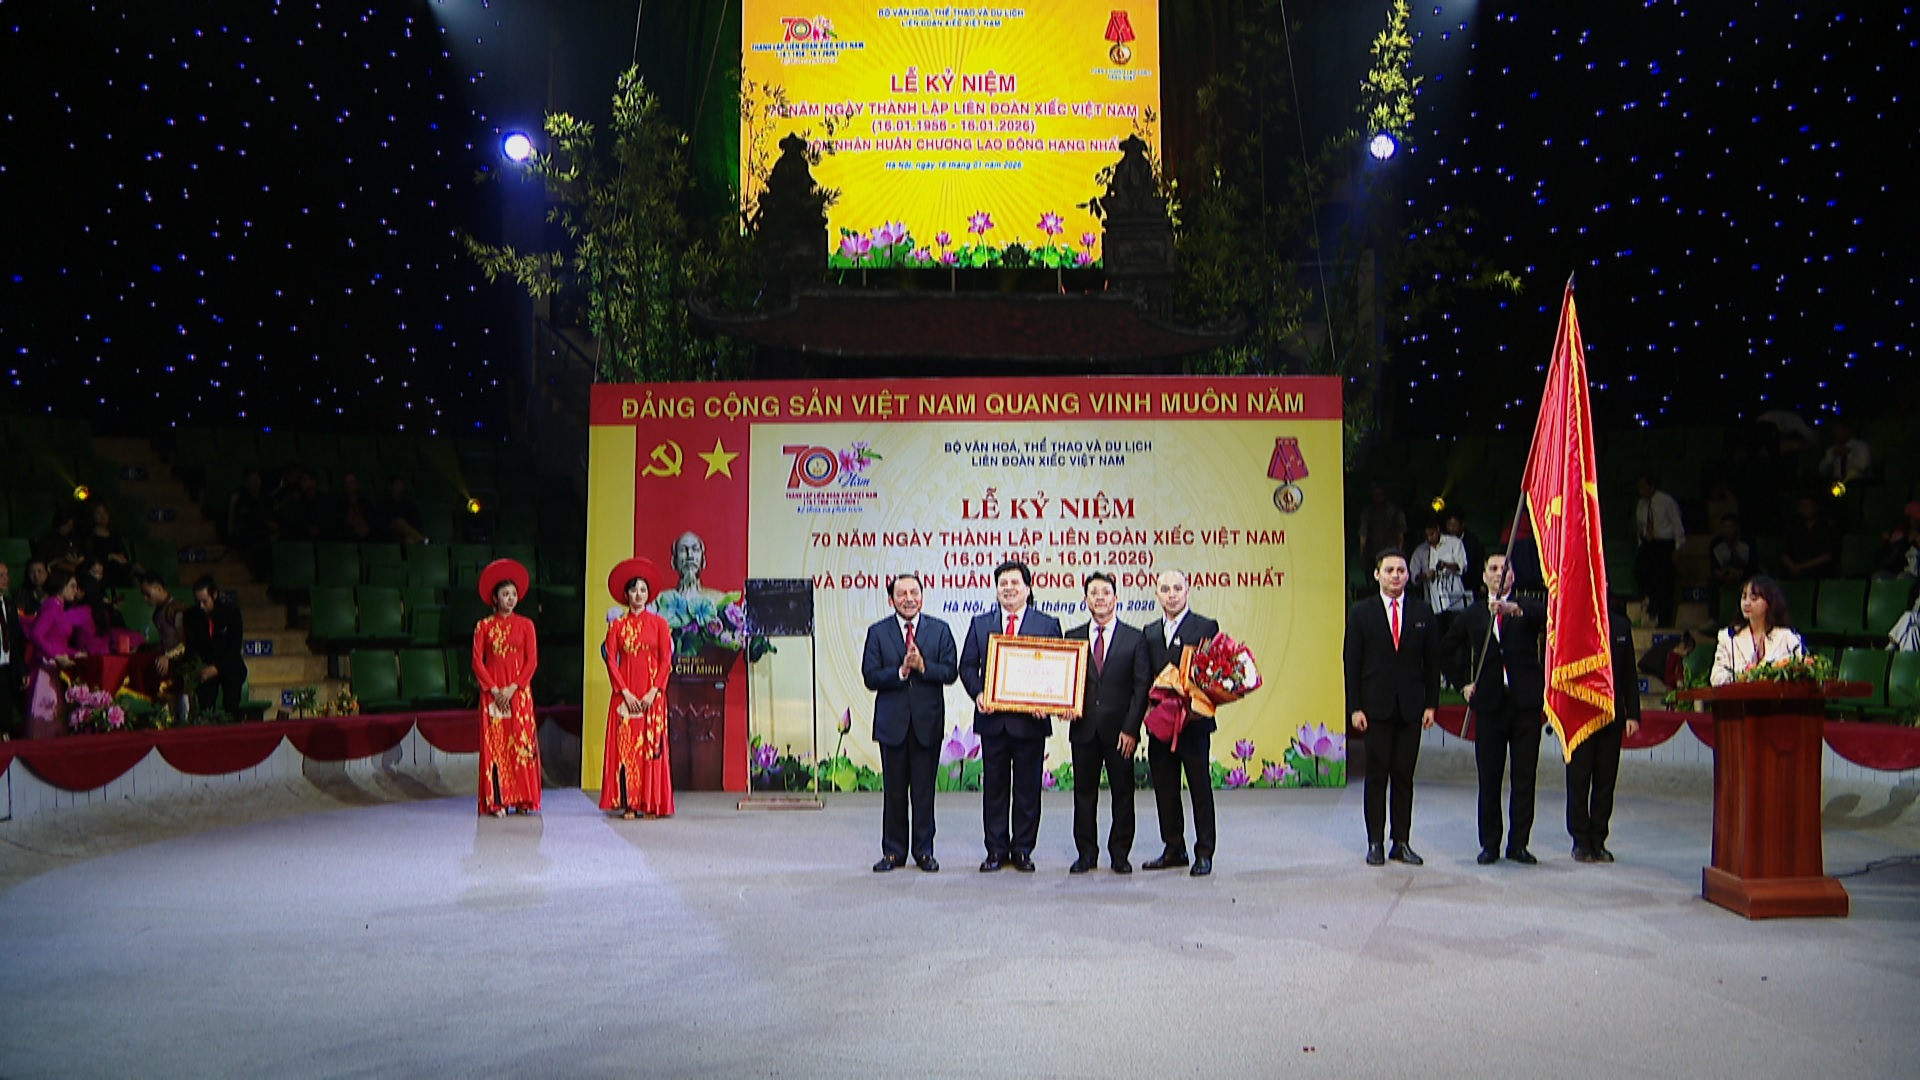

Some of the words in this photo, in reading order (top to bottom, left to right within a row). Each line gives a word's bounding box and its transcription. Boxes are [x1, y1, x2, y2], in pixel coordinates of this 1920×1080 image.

[954, 8, 975, 16] THAO
[991, 8, 1002, 16] DU
[782, 17, 812, 41] 70
[892, 66, 917, 92] LỄ
[926, 68, 954, 92] KỶ
[963, 70, 1015, 96] NIỆM
[789, 101, 819, 116] NĂM
[825, 100, 863, 115] NGÀY
[869, 101, 917, 115] THÀNH
[922, 101, 948, 117] LẬP
[954, 100, 985, 115] LIÊN
[990, 101, 1030, 115] ĐOÀN
[1035, 99, 1066, 115] XIẾC
[1072, 100, 1103, 119] VIỆT
[1107, 103, 1138, 116] NAM
[872, 119, 947, 134] (16.01.1956
[961, 119, 1035, 134] 16.01.2026)
[835, 136, 871, 152] NHẬN
[876, 136, 911, 150] HUÂN
[916, 137, 972, 151] CHƯƠNG
[977, 139, 1002, 151] LAO
[1007, 137, 1044, 152] ĐỘNG
[1050, 139, 1085, 153] HẠNG
[1090, 136, 1119, 151] NHẤ
[916, 162, 935, 171] ngày
[949, 161, 971, 171] tháng
[985, 161, 1001, 169] năm
[1004, 161, 1022, 169] 2026
[622, 390, 695, 419] ĐẢNG
[704, 391, 780, 422] CỘNG
[789, 386, 842, 416] SẢN
[852, 388, 909, 420] VIỆT
[919, 393, 976, 415] NAM
[985, 392, 1080, 416] QUANG
[1089, 392, 1151, 414] VINH
[1161, 386, 1238, 414] MUÔN
[1248, 386, 1304, 413] NĂM
[945, 440, 961, 454] BỘ
[965, 439, 988, 453] VĂN
[1024, 437, 1047, 453] THỂ
[1051, 441, 1083, 453] THAO
[1086, 438, 1100, 452] VÀ
[1105, 441, 1121, 452] DU
[1126, 440, 1151, 454] LỊCH
[783, 444, 838, 489] 70
[972, 455, 998, 467] LIÊN
[1002, 455, 1035, 466] ĐOÀN
[1039, 453, 1065, 466] XIẾC
[1070, 454, 1095, 468] VIỆT
[1100, 455, 1125, 466] NAM
[962, 487, 1000, 519] LỄ
[1011, 490, 1049, 519] KỶ
[1060, 490, 1135, 525] NIỆM
[812, 532, 830, 547] 70
[837, 529, 876, 547] NĂM
[883, 528, 933, 547] NGÀY
[939, 528, 1001, 547] THÀNH
[1008, 528, 1042, 550] LẬP
[1050, 527, 1089, 546] LIÊN
[1096, 526, 1147, 545] ĐOÀN
[1154, 524, 1194, 545] XIẾC
[1201, 526, 1240, 548] VIỆT
[1247, 530, 1285, 545] NAM
[944, 551, 1040, 570] (16.01.1956
[1058, 551, 1154, 569] 16.01.2026)
[812, 570, 835, 589] VÀ
[841, 570, 878, 589] ĐÓN
[941, 570, 991, 589] HUÂN
[1123, 568, 1160, 591] ĐỘN
[1238, 566, 1284, 587] NHẤT
[943, 600, 958, 613] Hà
[963, 600, 985, 614] Nội,
[1042, 600, 1075, 614] tháng
